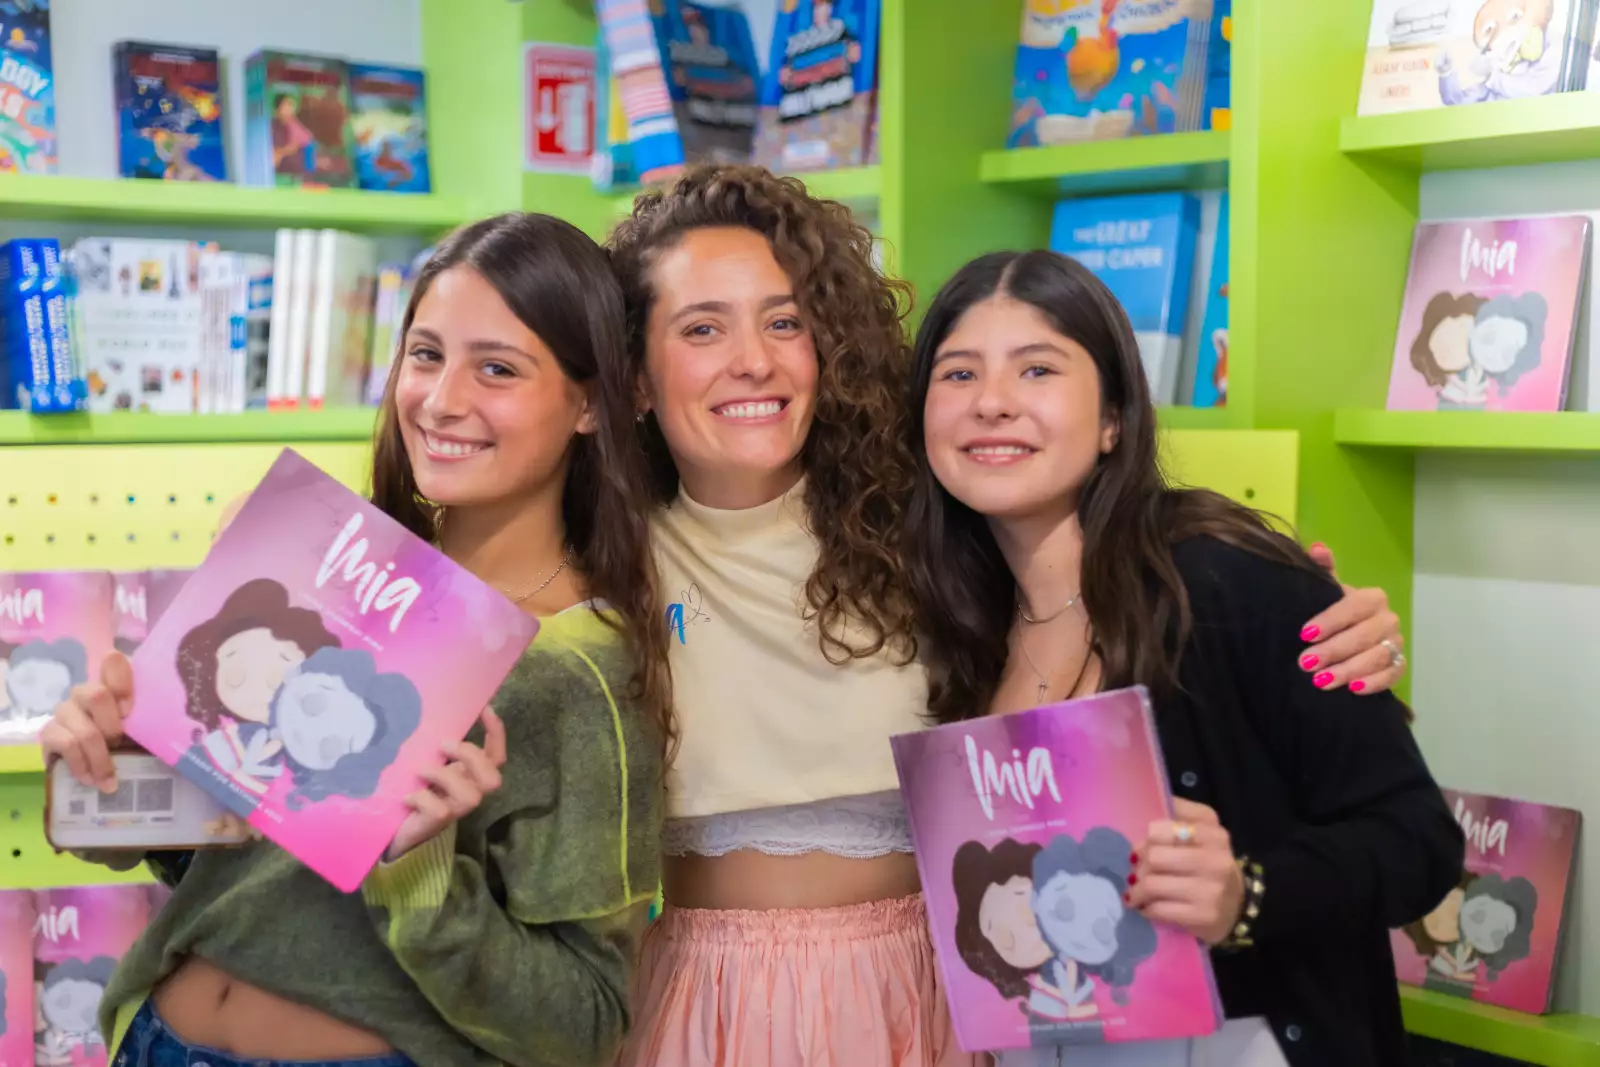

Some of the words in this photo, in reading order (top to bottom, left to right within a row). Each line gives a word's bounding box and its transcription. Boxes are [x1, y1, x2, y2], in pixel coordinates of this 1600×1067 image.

[1459, 228, 1518, 282] Mia
[316, 512, 422, 633] Mia
[965, 734, 1063, 821] Mia
